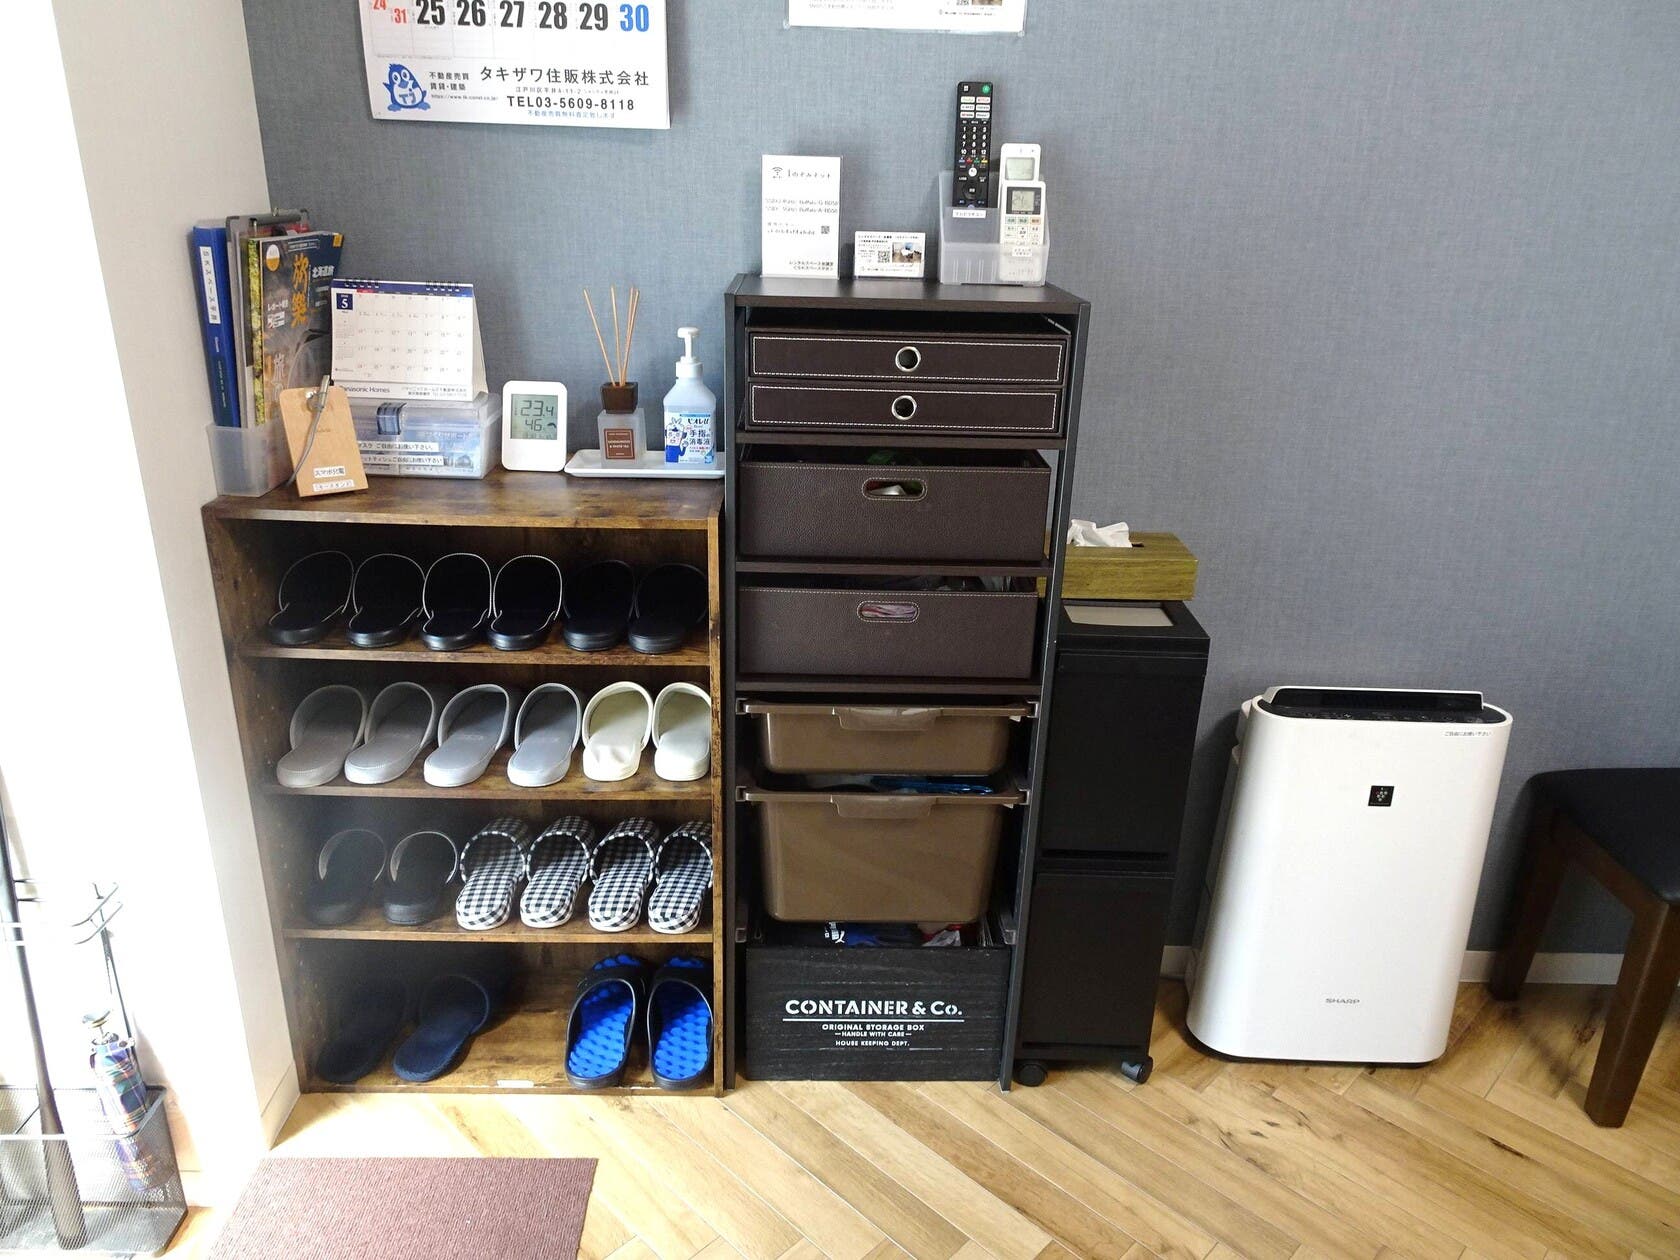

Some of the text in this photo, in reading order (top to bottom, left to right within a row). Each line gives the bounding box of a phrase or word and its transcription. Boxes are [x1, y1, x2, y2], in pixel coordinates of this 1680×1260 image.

[393, 8, 407, 24] 31
[416, 0, 446, 25] 25
[456, 0, 486, 26] 26
[499, 0, 525, 28] 27
[538, 1, 568, 30] 28
[579, 2, 609, 31] 29
[619, 3, 650, 32] 30
[429, 71, 469, 81] 不動産売買
[480, 66, 649, 86] タキザワ住販株式会社
[506, 95, 634, 111] TEL03-5609-8118
[341, 298, 348, 309] 5
[520, 399, 554, 417] 23.4
[525, 418, 542, 432] 46
[785, 999, 962, 1016] CONTAINER & Co.
[822, 1023, 863, 1031] ORIGINAL
[865, 1023, 905, 1031] STORAGE
